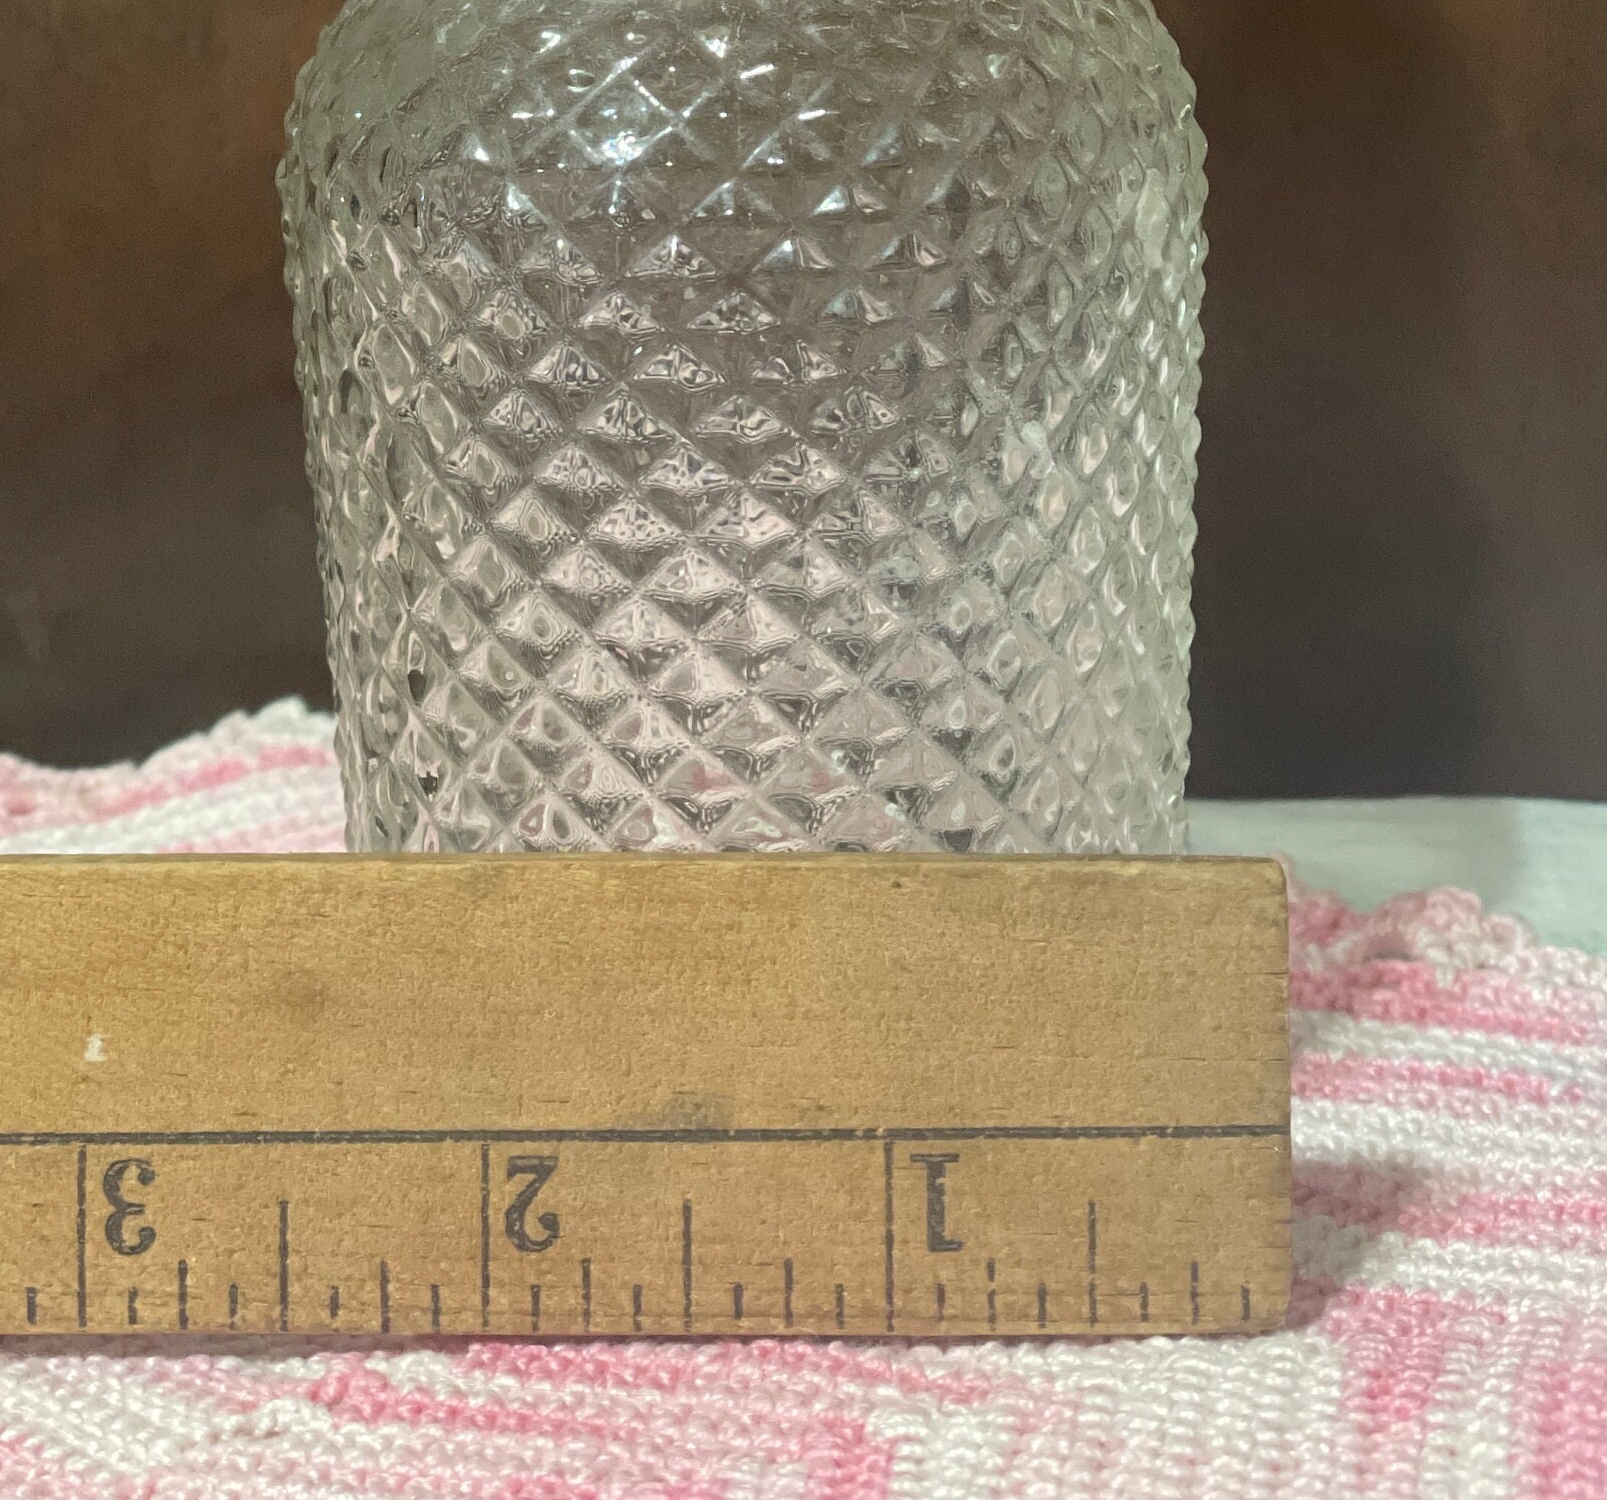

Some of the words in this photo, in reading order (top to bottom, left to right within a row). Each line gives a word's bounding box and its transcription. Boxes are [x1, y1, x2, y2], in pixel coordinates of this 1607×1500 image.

[101, 1157, 156, 1256] 3
[504, 1154, 560, 1253] 2
[909, 1152, 964, 1252] 1
